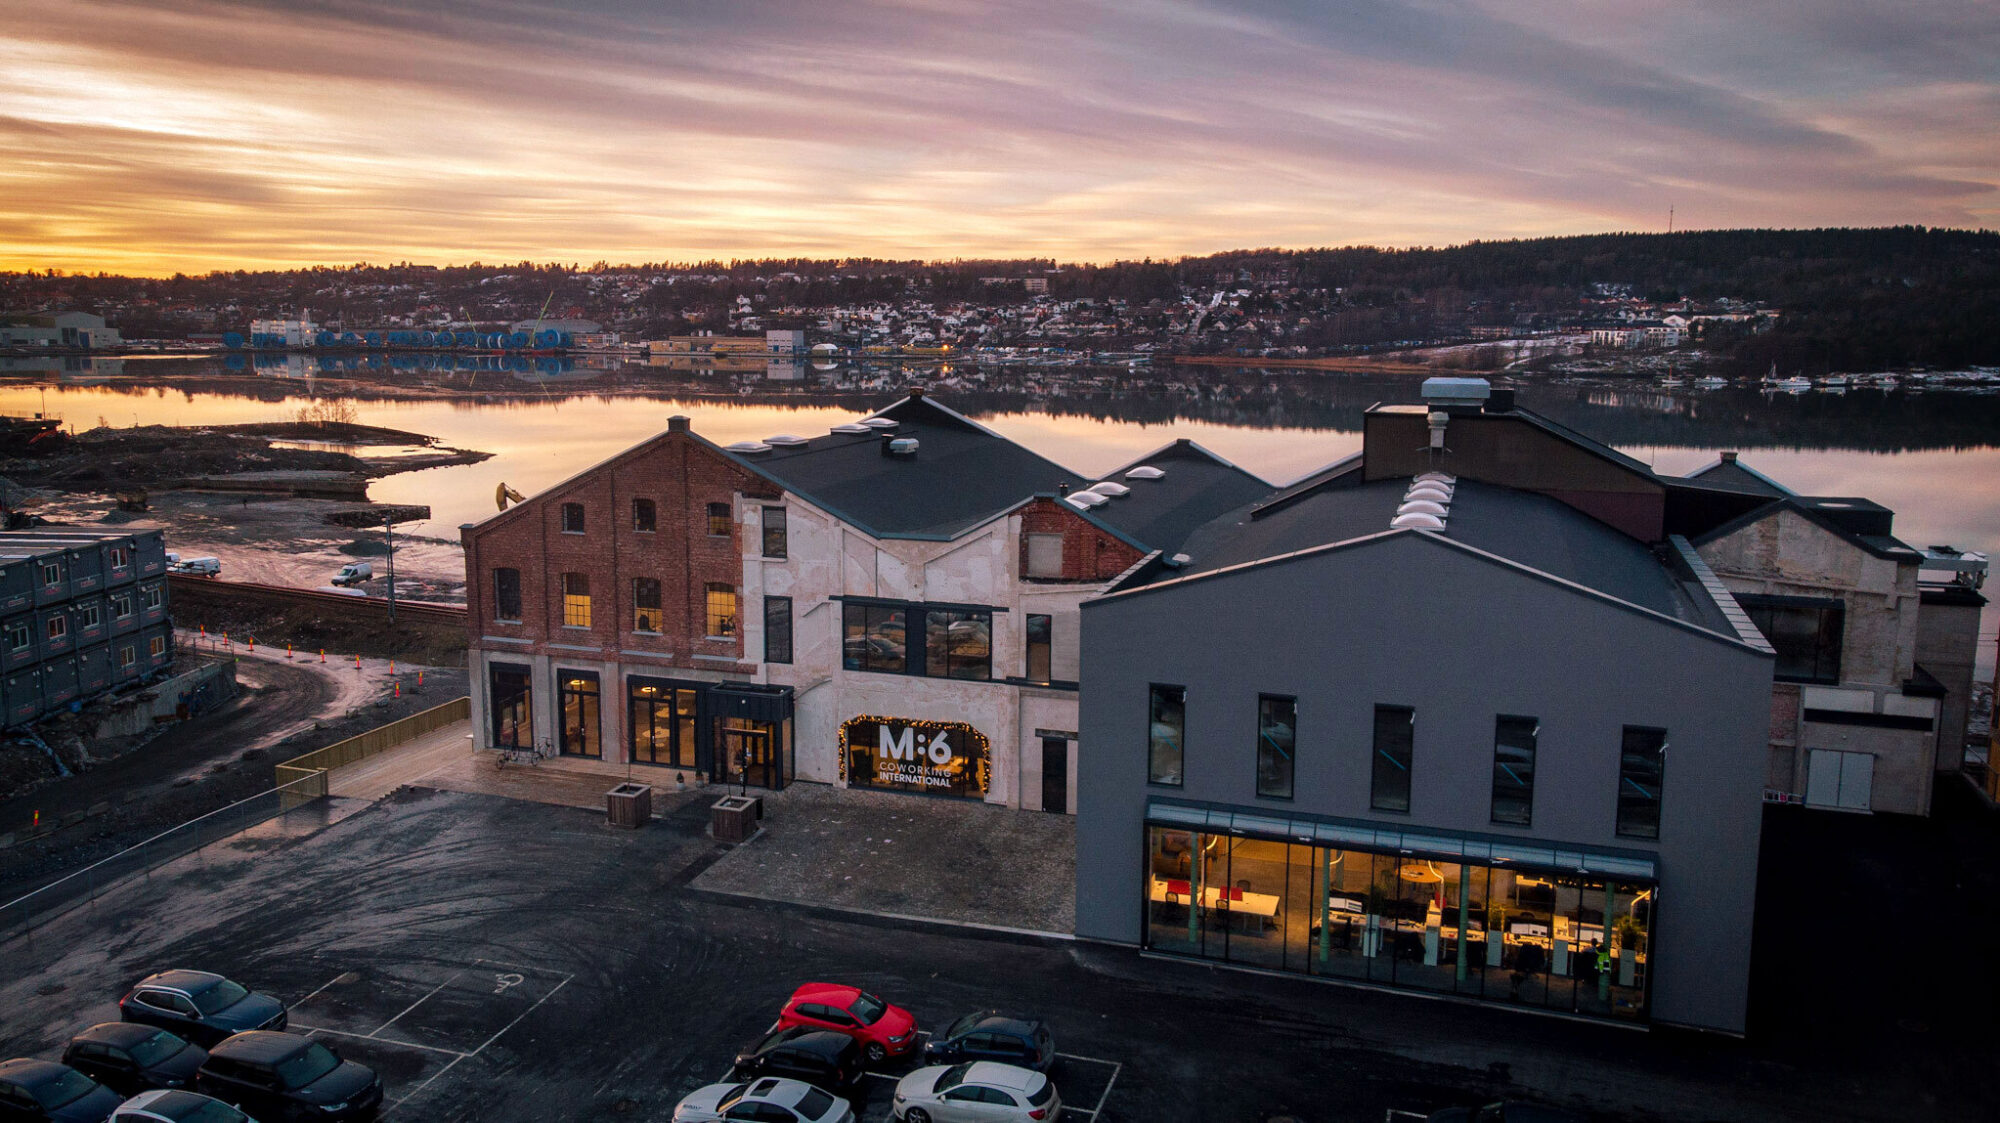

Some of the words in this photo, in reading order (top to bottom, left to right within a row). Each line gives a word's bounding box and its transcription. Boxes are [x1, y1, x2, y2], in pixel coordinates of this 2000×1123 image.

[880, 725, 952, 764] M:6
[880, 762, 952, 778] COWORKING
[880, 772, 952, 788] INTERNATIONAL
